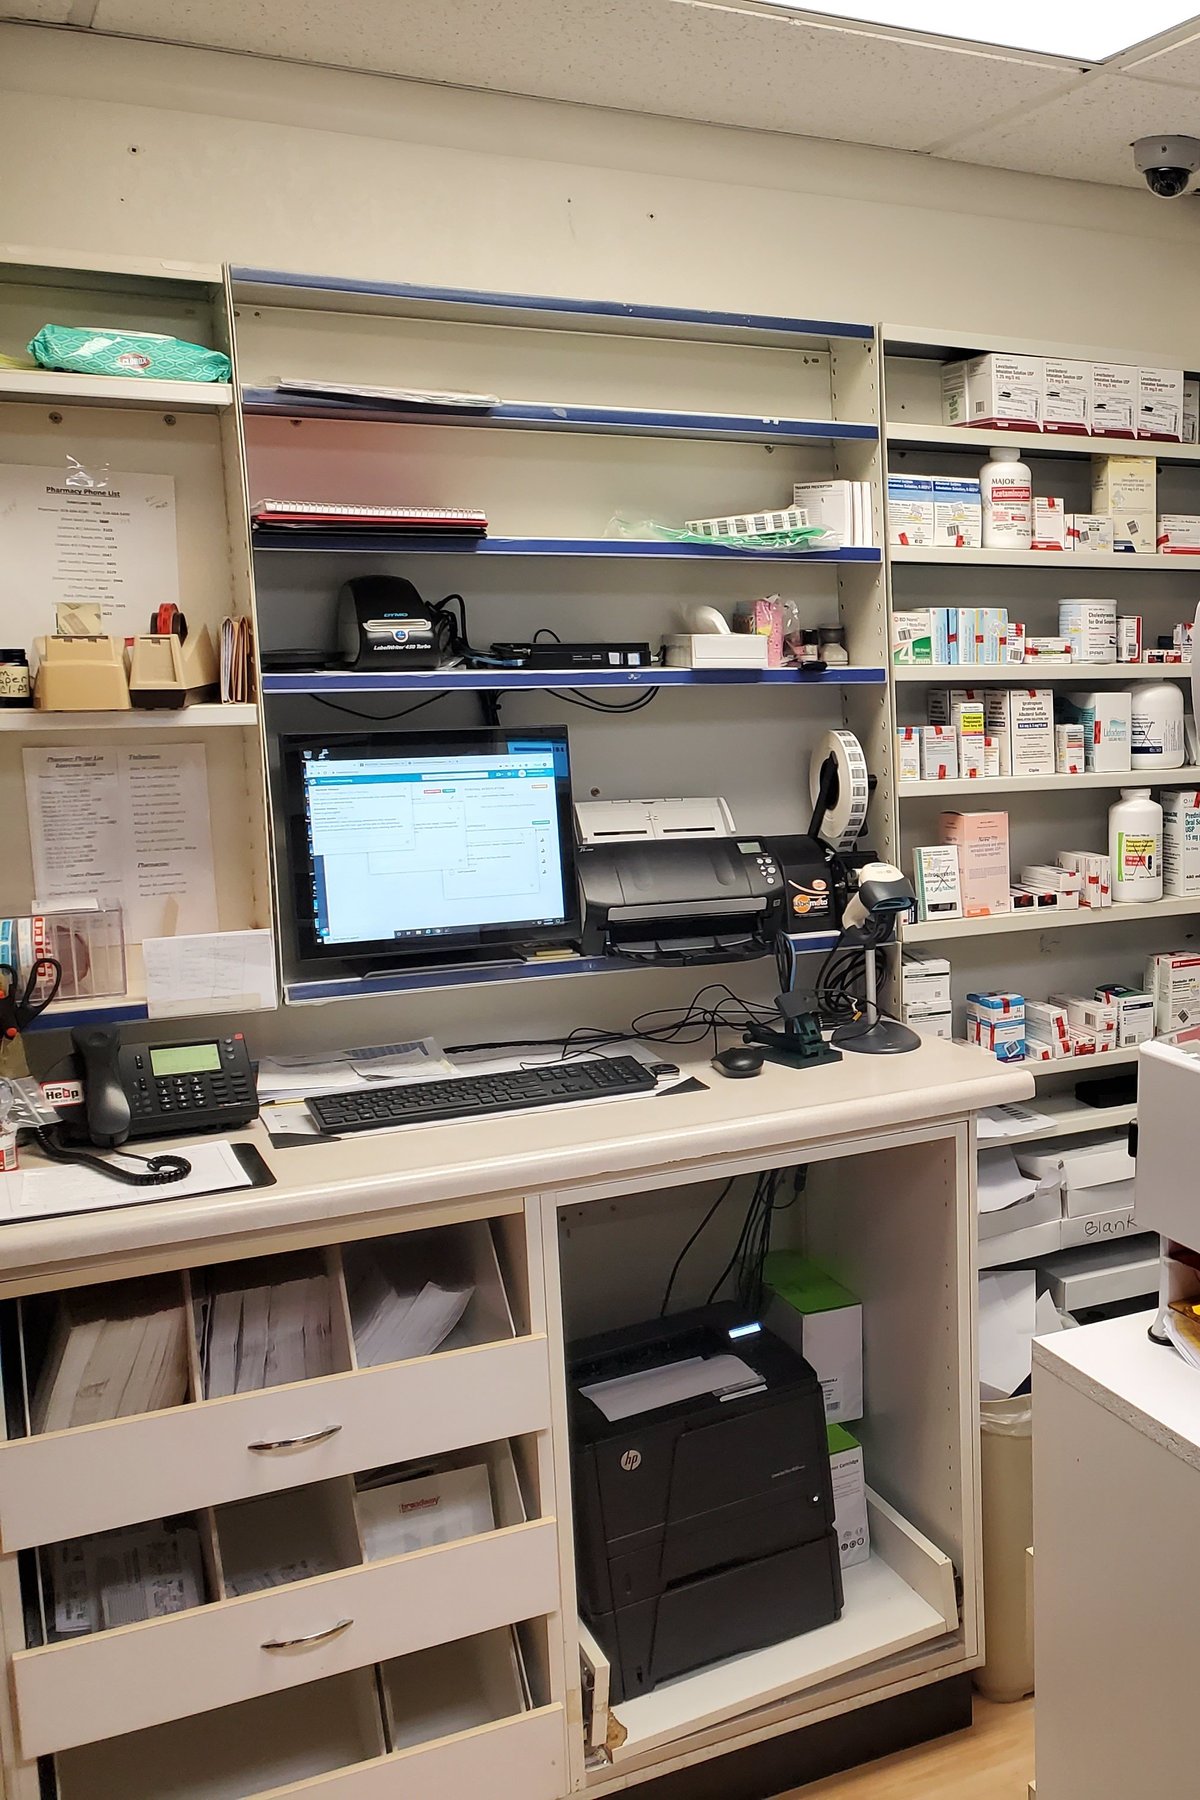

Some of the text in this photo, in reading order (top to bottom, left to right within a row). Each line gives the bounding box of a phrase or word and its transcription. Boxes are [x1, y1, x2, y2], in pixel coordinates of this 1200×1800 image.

[46, 486, 120, 498] Pharmacy Phone List
[1085, 1214, 1138, 1237] Blank
[625, 1450, 639, 1470] hp
